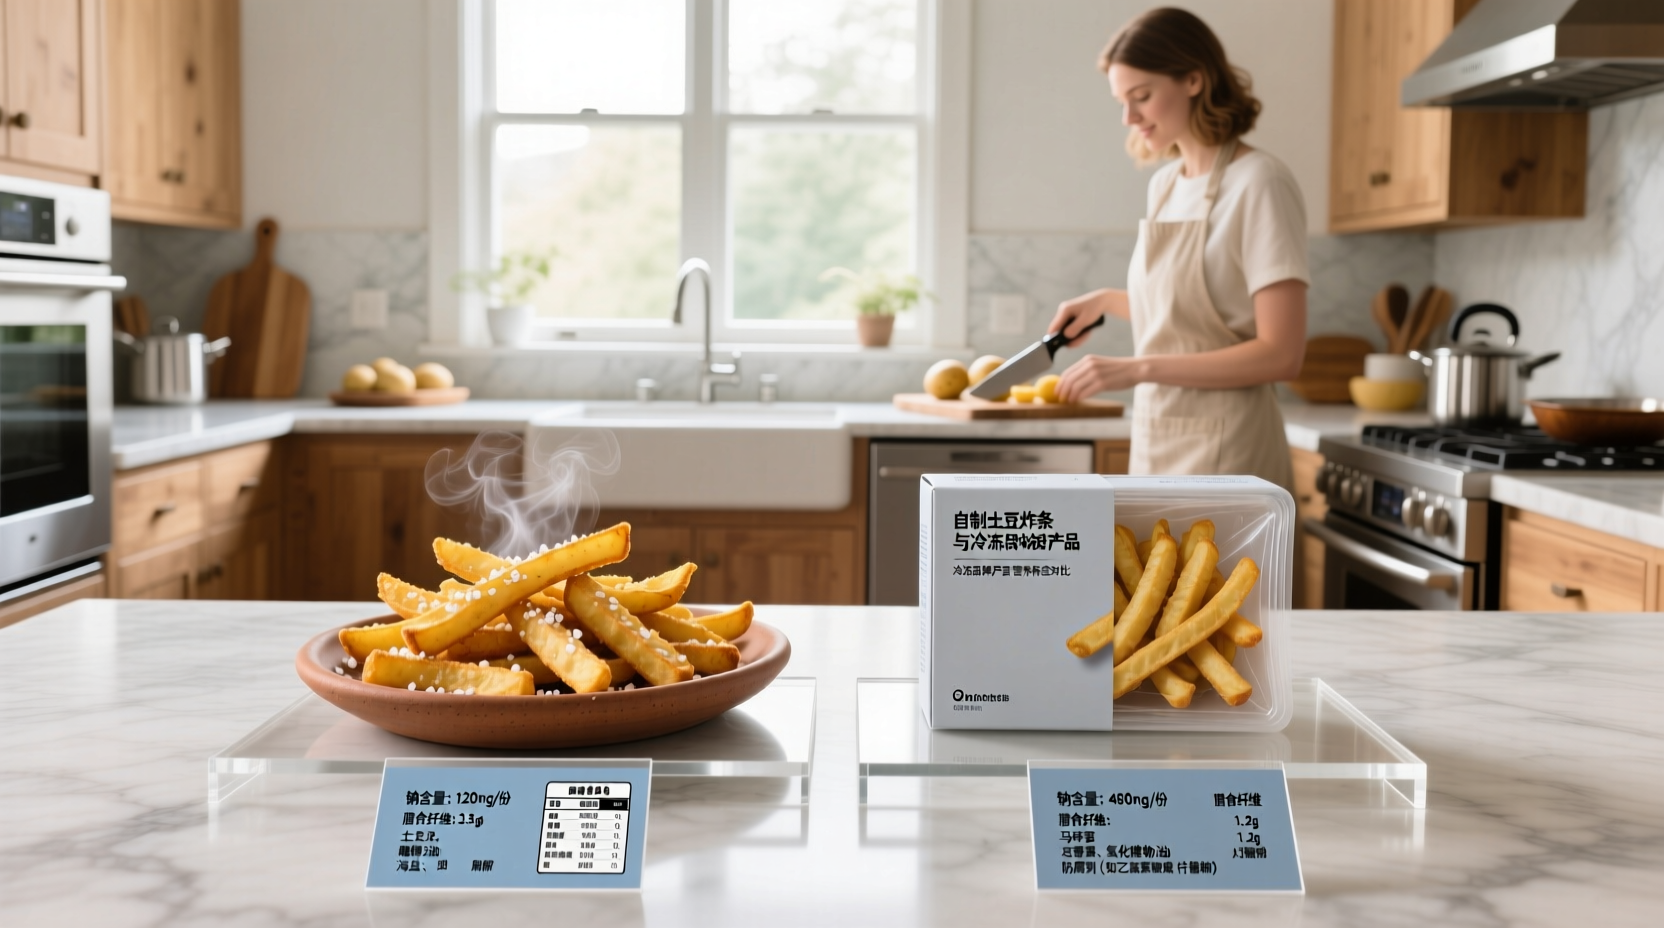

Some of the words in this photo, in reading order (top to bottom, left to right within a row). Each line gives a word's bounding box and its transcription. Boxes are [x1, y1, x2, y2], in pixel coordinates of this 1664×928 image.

[954, 510, 1054, 530] 自制土豆炸条
[1234, 815, 1259, 829] 1.2g
